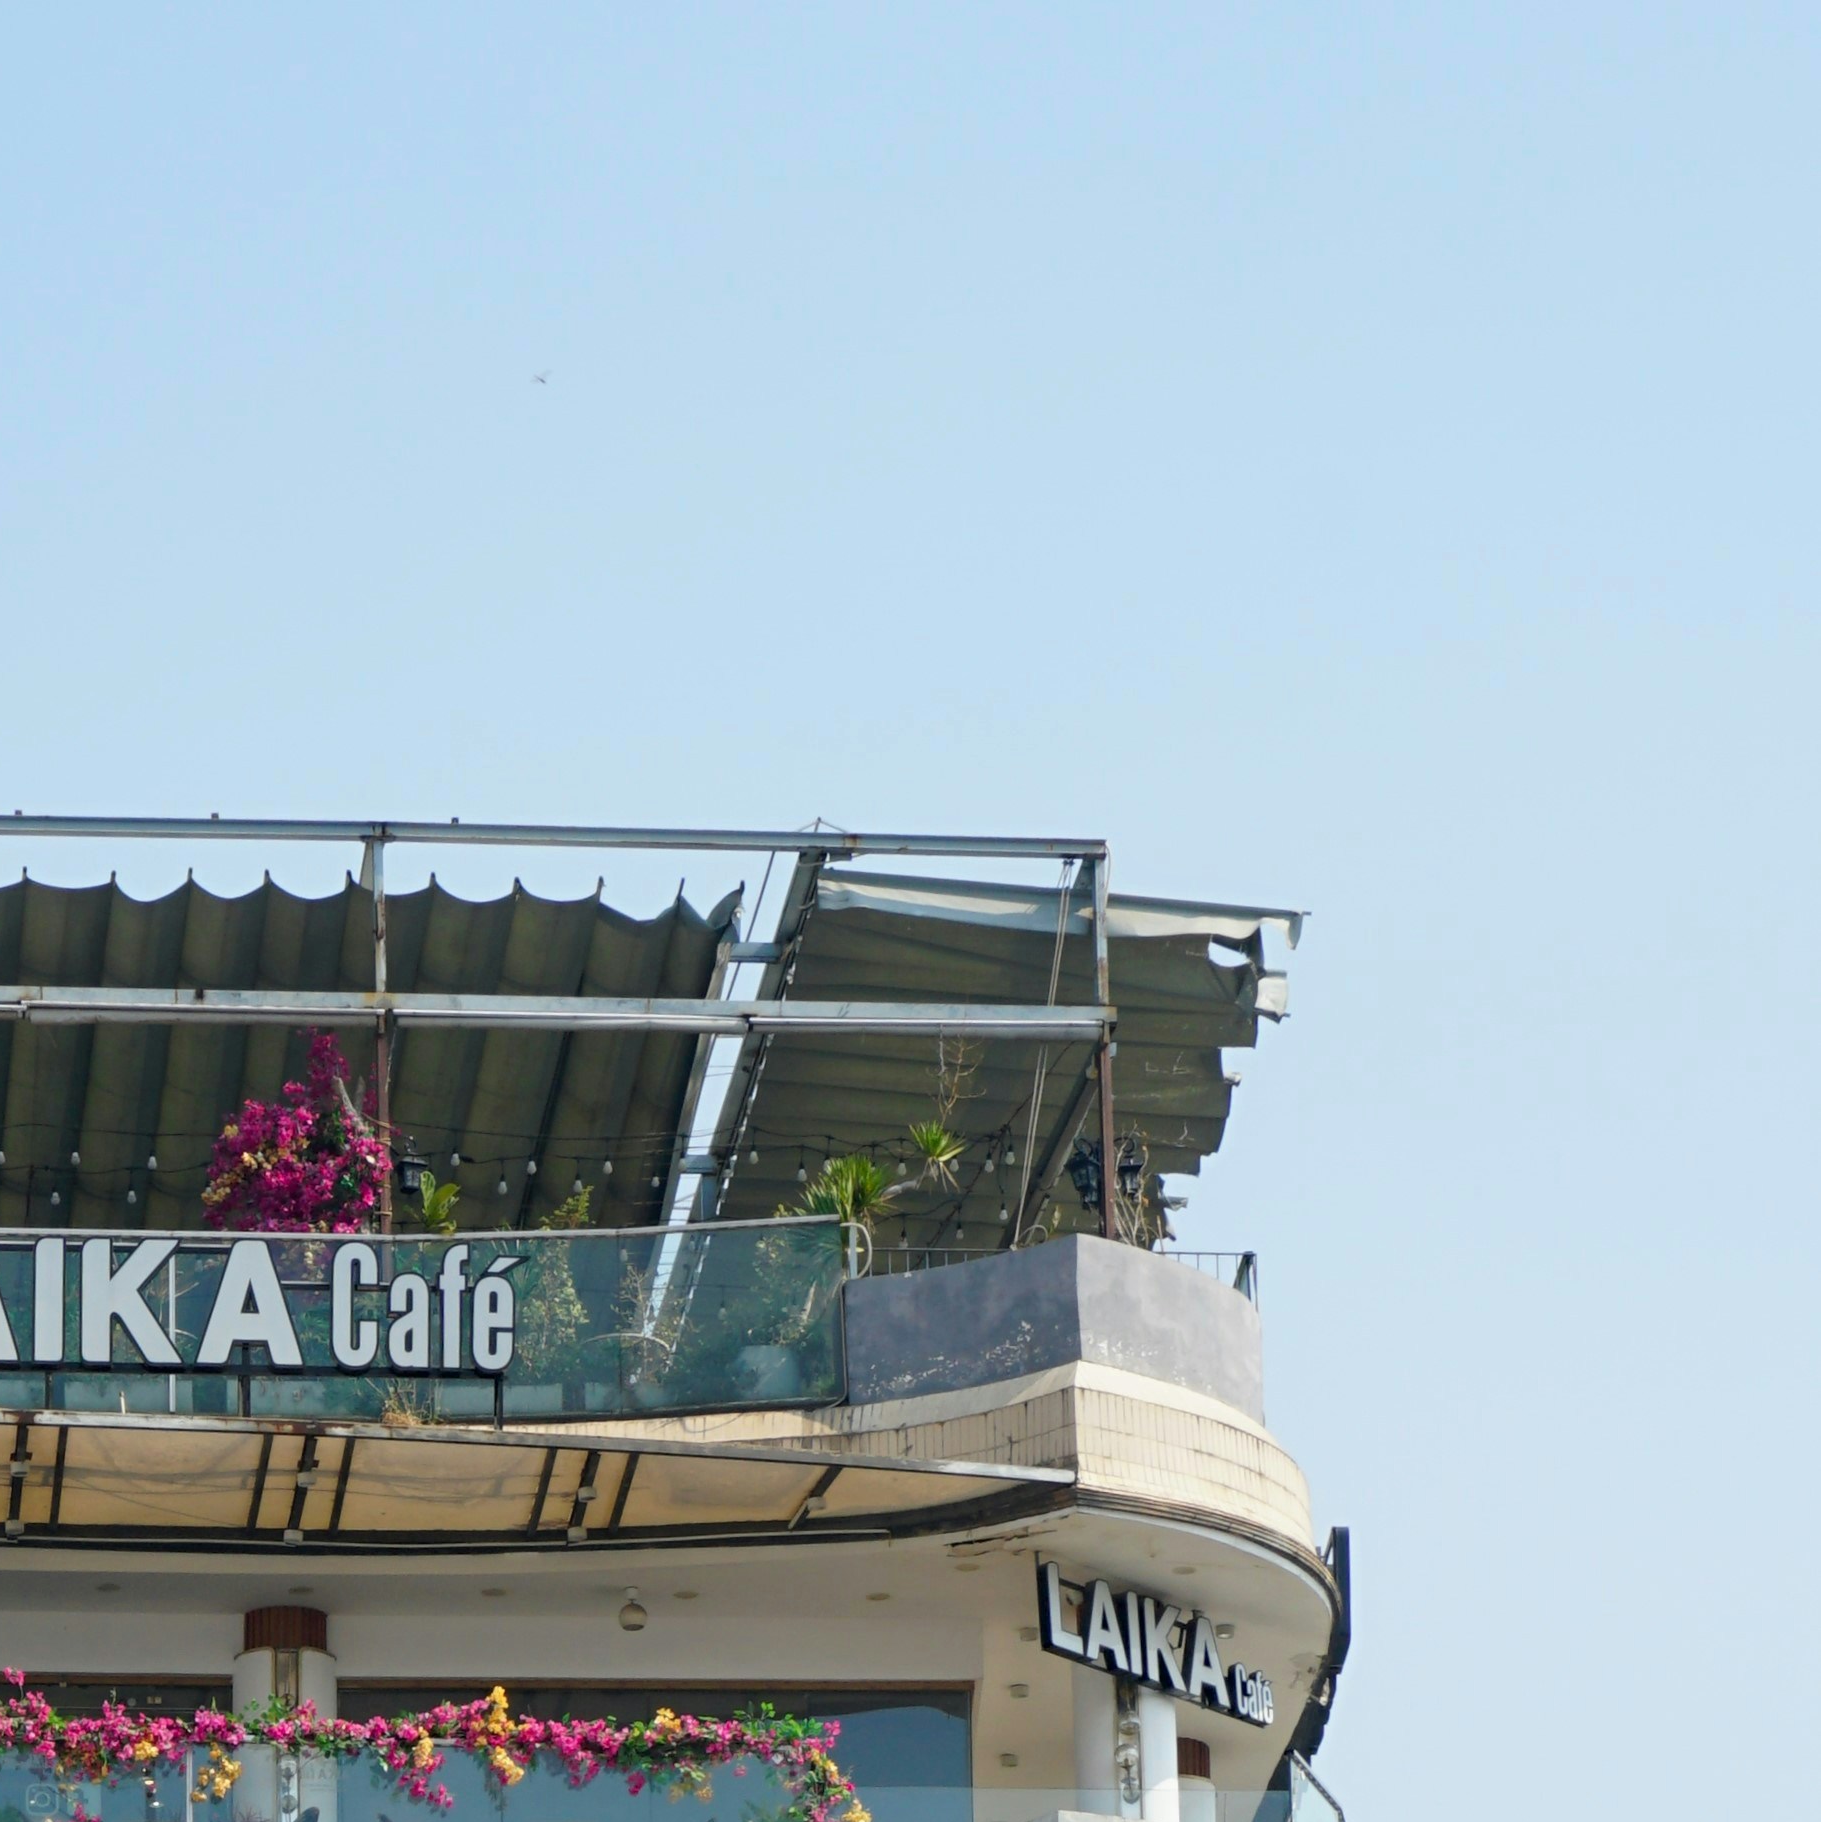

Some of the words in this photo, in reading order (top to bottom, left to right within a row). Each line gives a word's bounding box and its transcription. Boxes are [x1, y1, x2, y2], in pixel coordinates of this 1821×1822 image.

[331, 1242, 532, 1371] Café
[1038, 1561, 1230, 1710] LAIKA
[1228, 1661, 1275, 1727] Café
